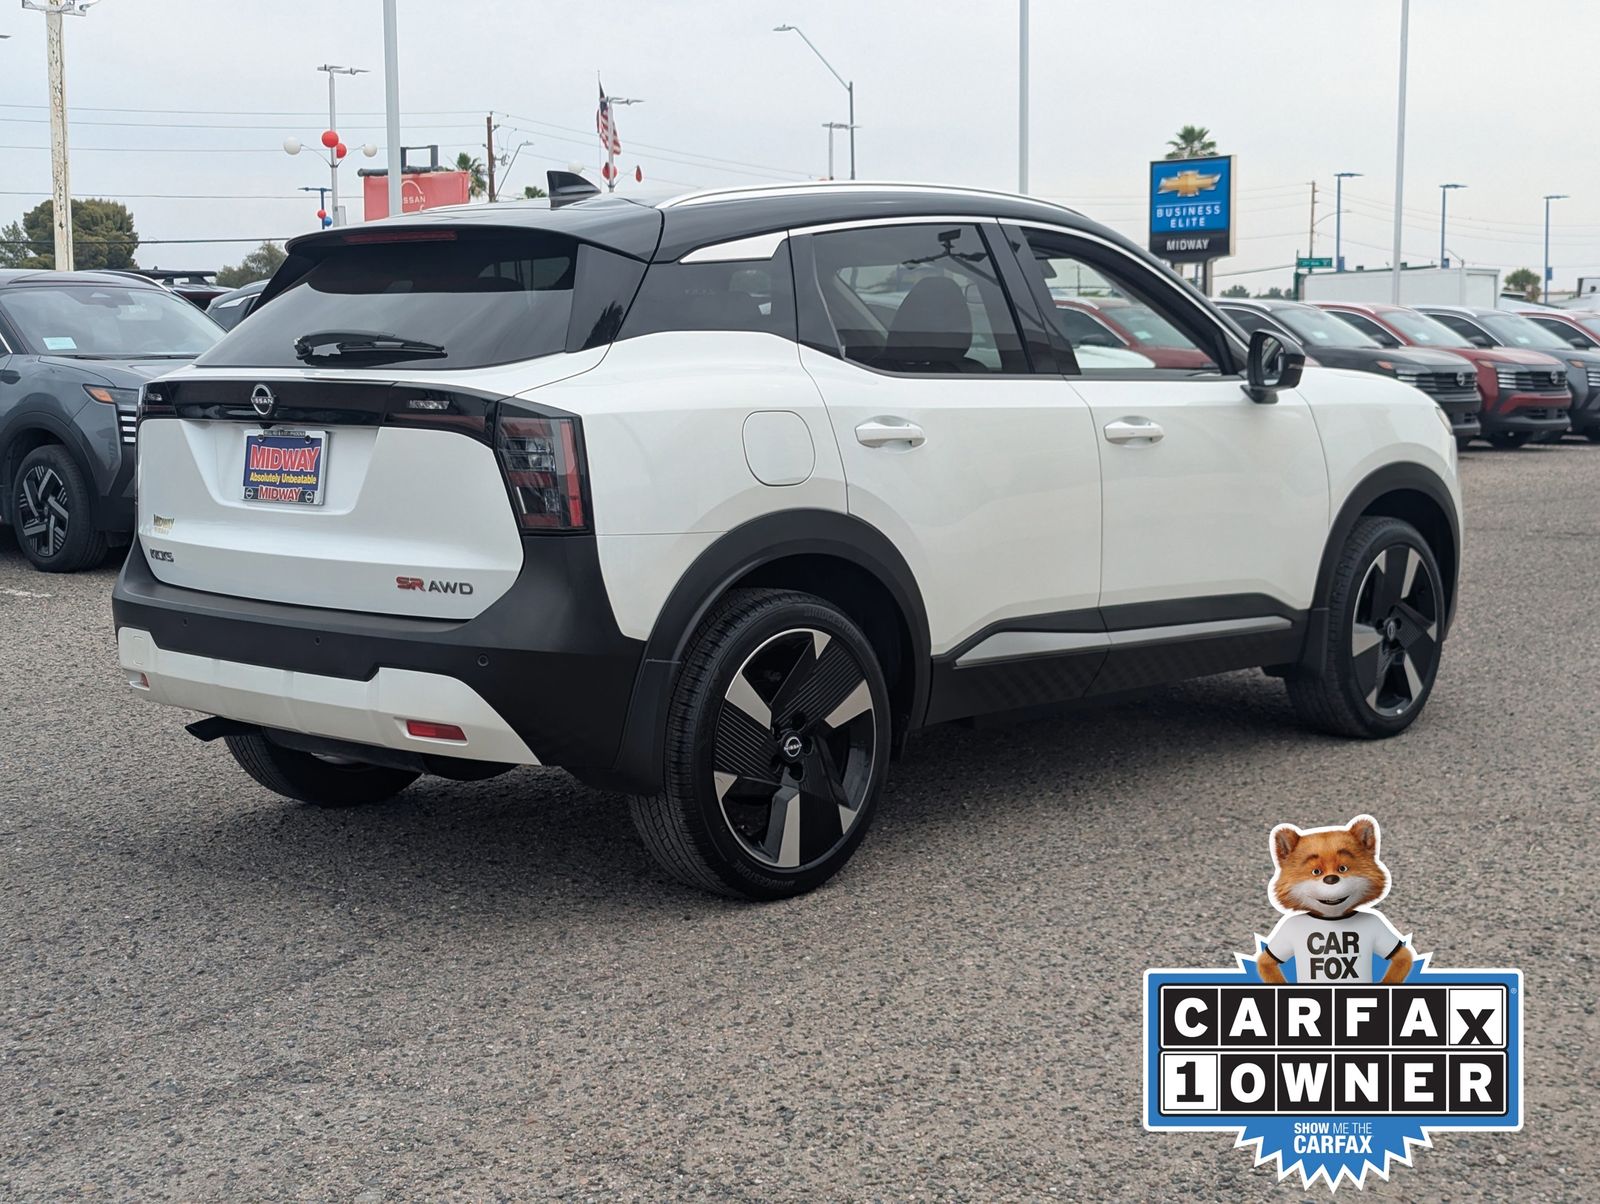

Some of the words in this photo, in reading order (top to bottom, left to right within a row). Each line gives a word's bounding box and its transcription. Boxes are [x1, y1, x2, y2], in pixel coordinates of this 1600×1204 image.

[403, 196, 425, 205] SSAN
[1156, 205, 1220, 218] BUSINESS
[1170, 217, 1205, 228] ELITE
[1166, 239, 1209, 251] MIDWAY
[250, 444, 320, 472] MIDWAY
[250, 472, 280, 484] Absolutely
[281, 474, 317, 484] Unbeatable
[258, 485, 302, 502] MIDWAY
[396, 576, 426, 592] SR
[428, 580, 474, 595] AWD
